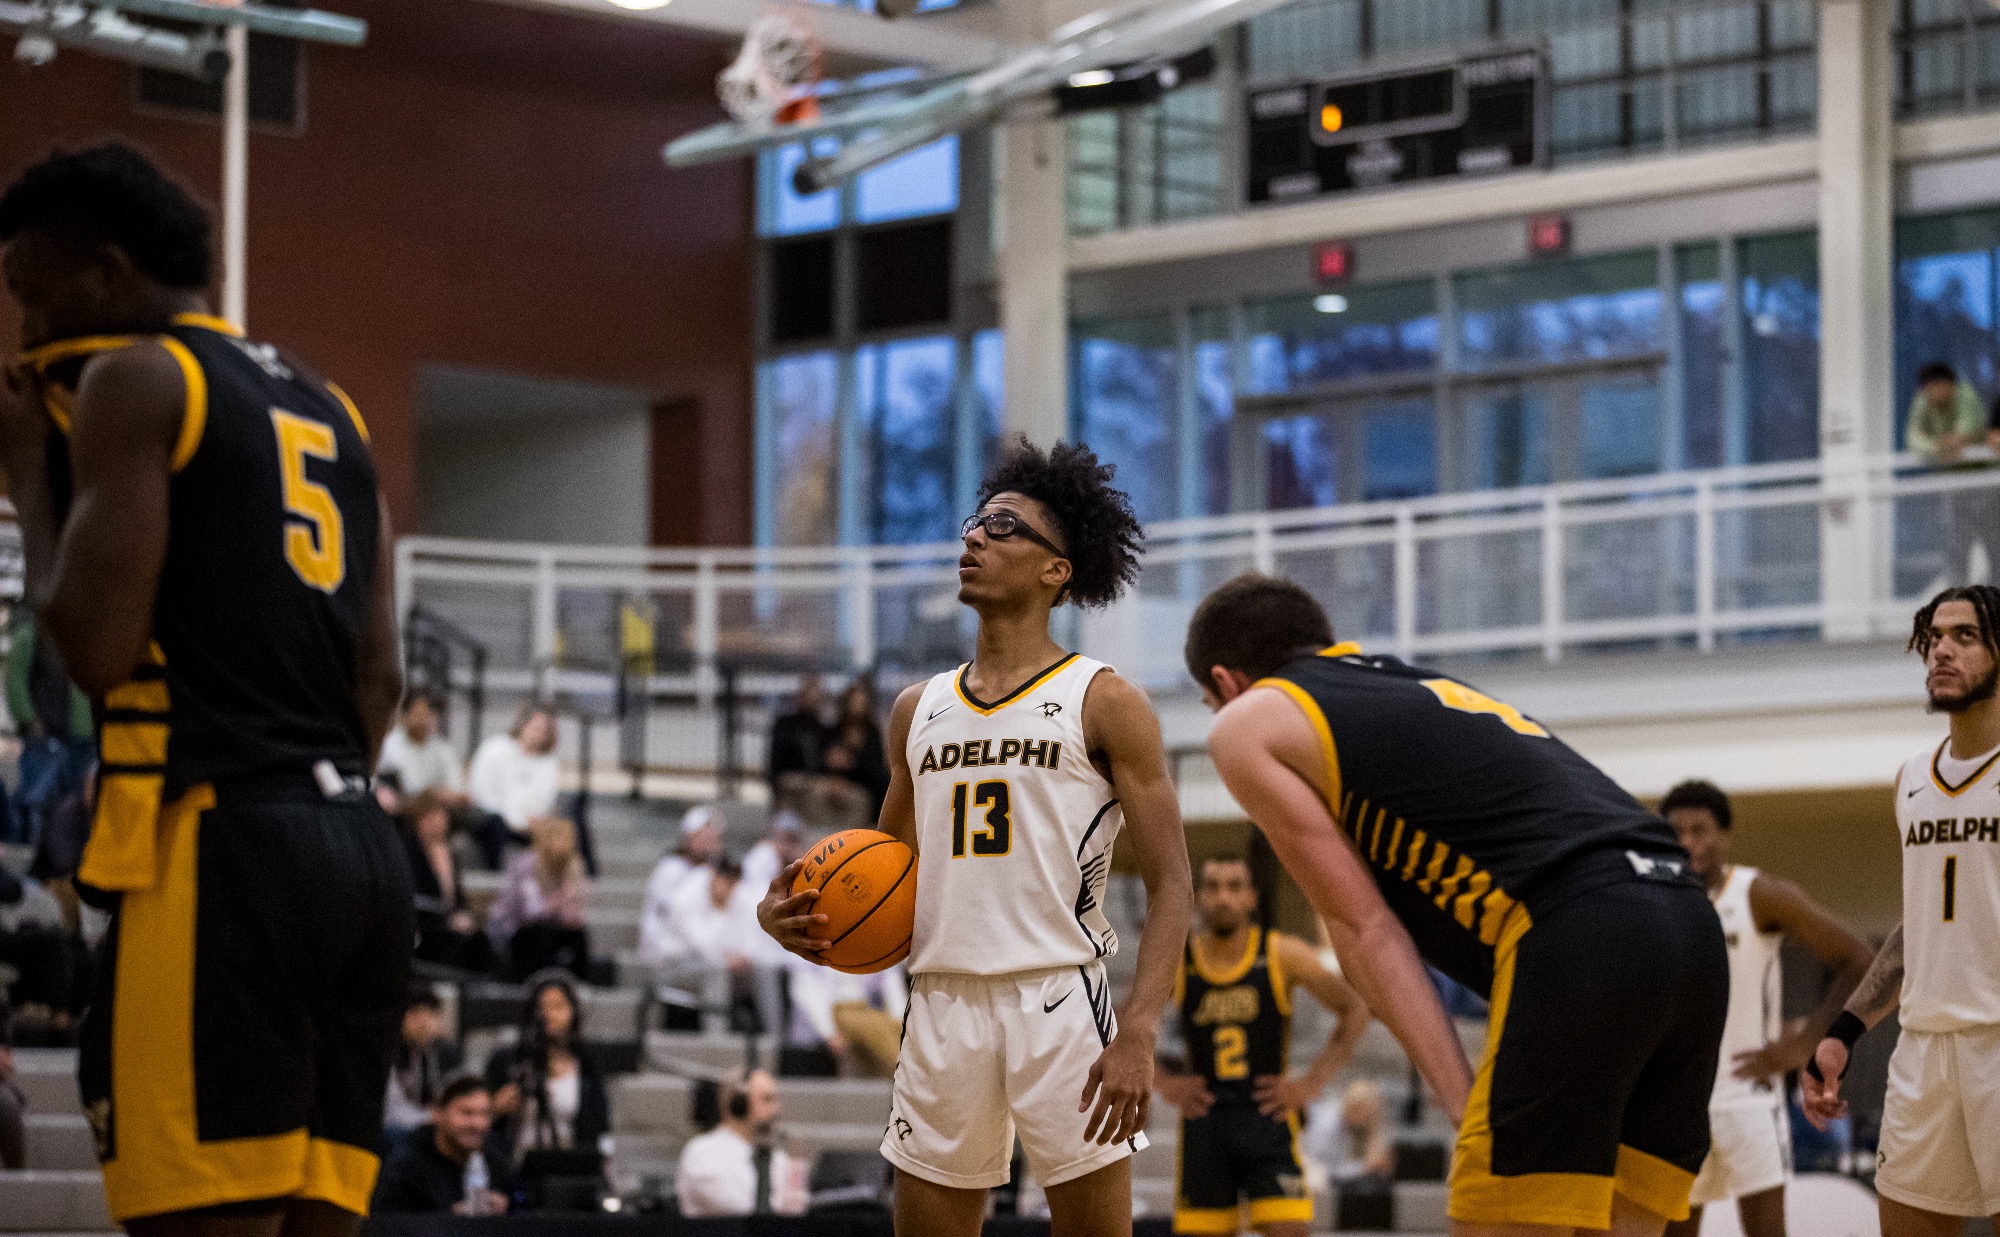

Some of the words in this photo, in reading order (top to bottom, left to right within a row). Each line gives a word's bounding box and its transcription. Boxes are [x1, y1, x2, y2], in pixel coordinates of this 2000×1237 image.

[270, 406, 346, 595] 5
[918, 738, 1061, 776] ADELPHI
[951, 779, 1013, 860] 13
[1905, 817, 2000, 847] ADELPH
[1942, 854, 1957, 923] 1
[1213, 1025, 1249, 1080] 2
